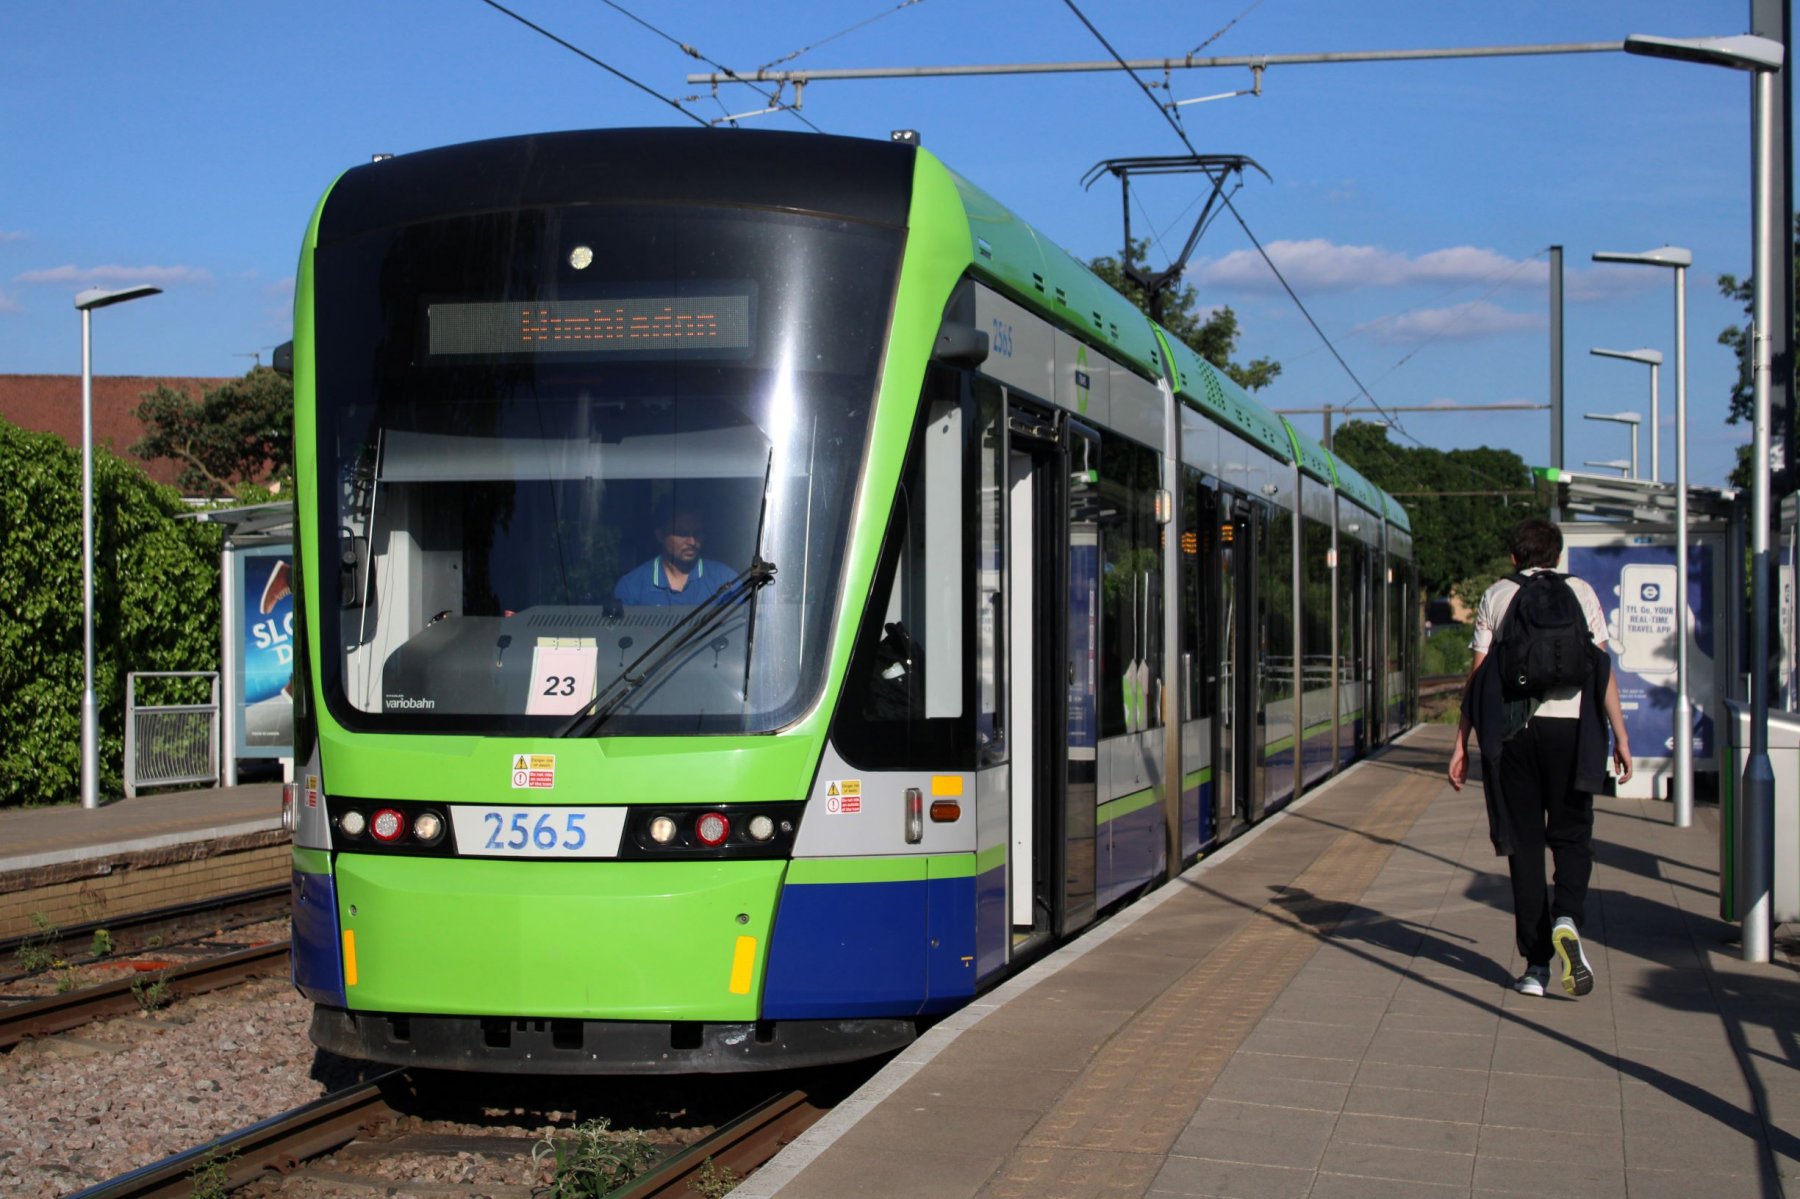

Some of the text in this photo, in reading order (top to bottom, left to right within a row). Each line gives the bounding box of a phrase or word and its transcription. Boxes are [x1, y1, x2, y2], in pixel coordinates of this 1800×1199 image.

[1655, 606, 1673, 614] YOUR
[1628, 624, 1671, 633] TRAVEL APP
[543, 676, 576, 696] 23
[386, 697, 435, 709] variobahn
[484, 813, 586, 850] 2565
